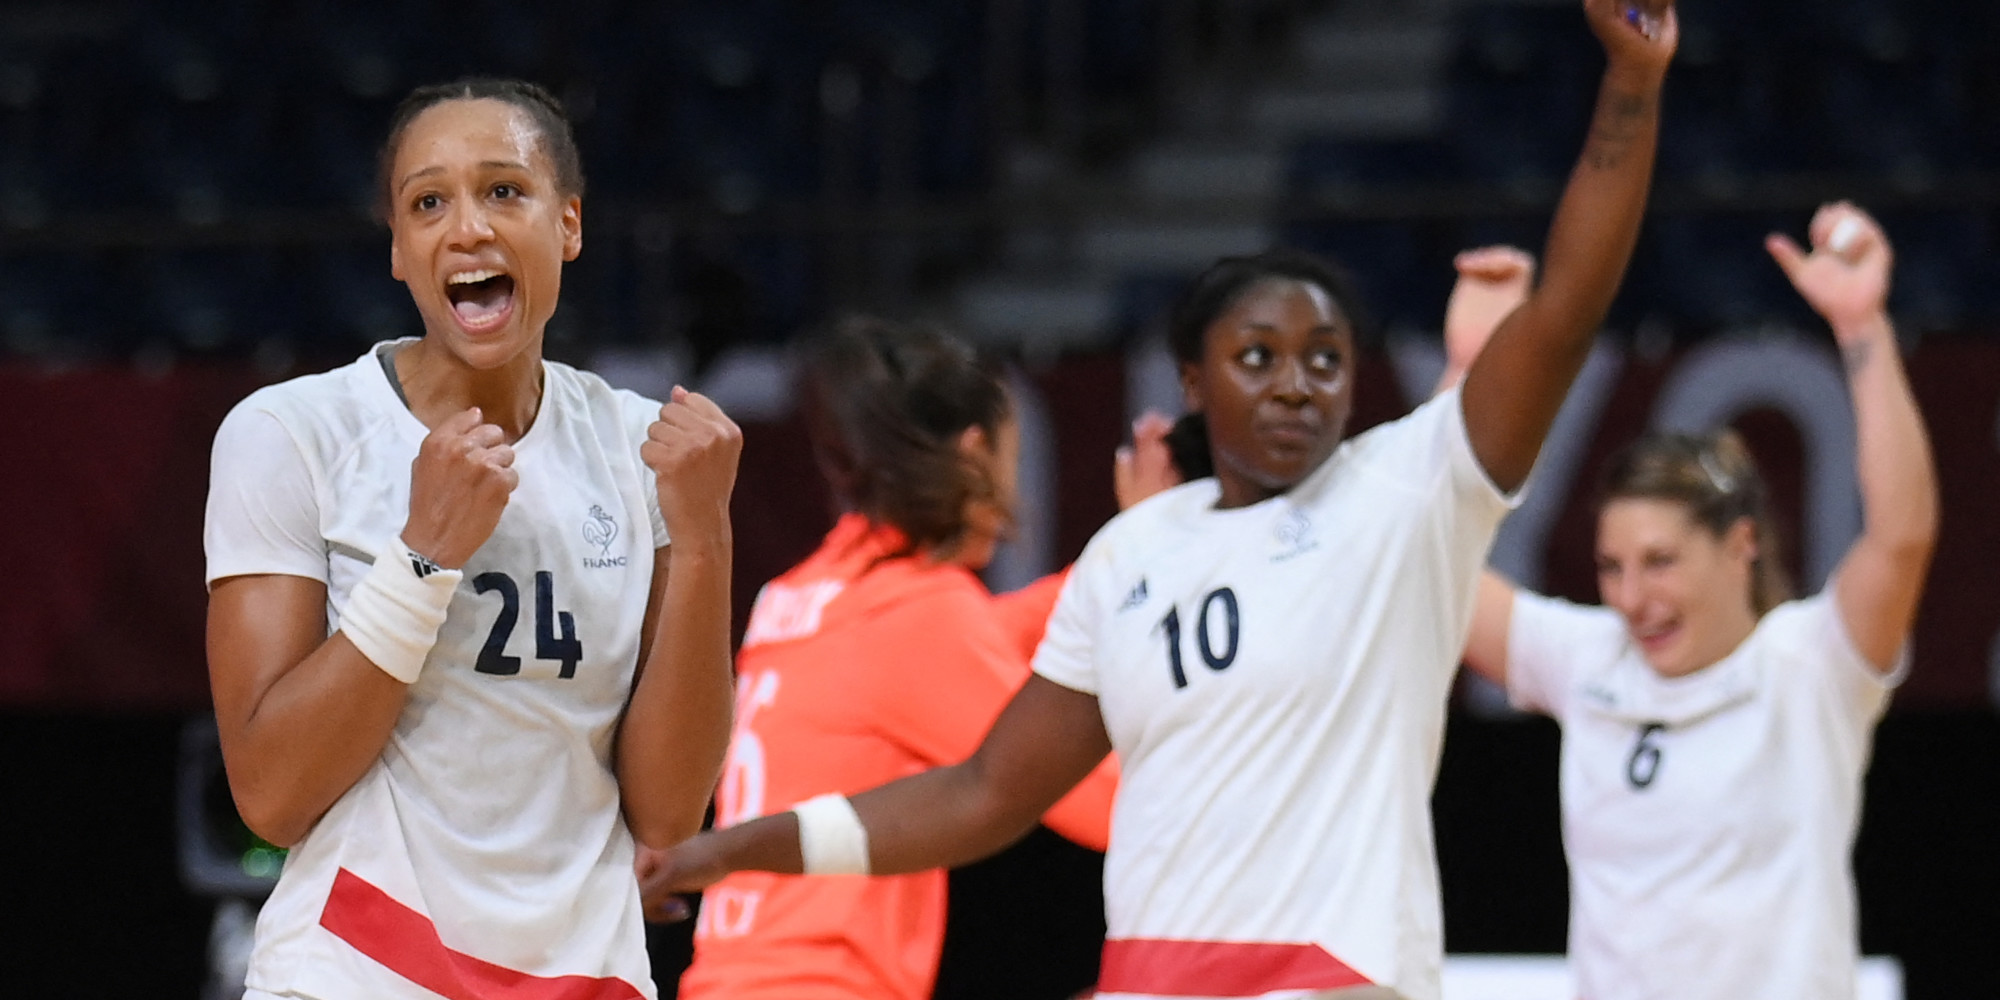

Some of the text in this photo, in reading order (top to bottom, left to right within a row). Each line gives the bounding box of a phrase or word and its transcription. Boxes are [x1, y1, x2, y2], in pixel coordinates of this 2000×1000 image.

[583, 556, 628, 568] FRANC
[472, 570, 583, 680] 24
[1160, 585, 1240, 690] 10
[1626, 721, 1667, 790] 6
